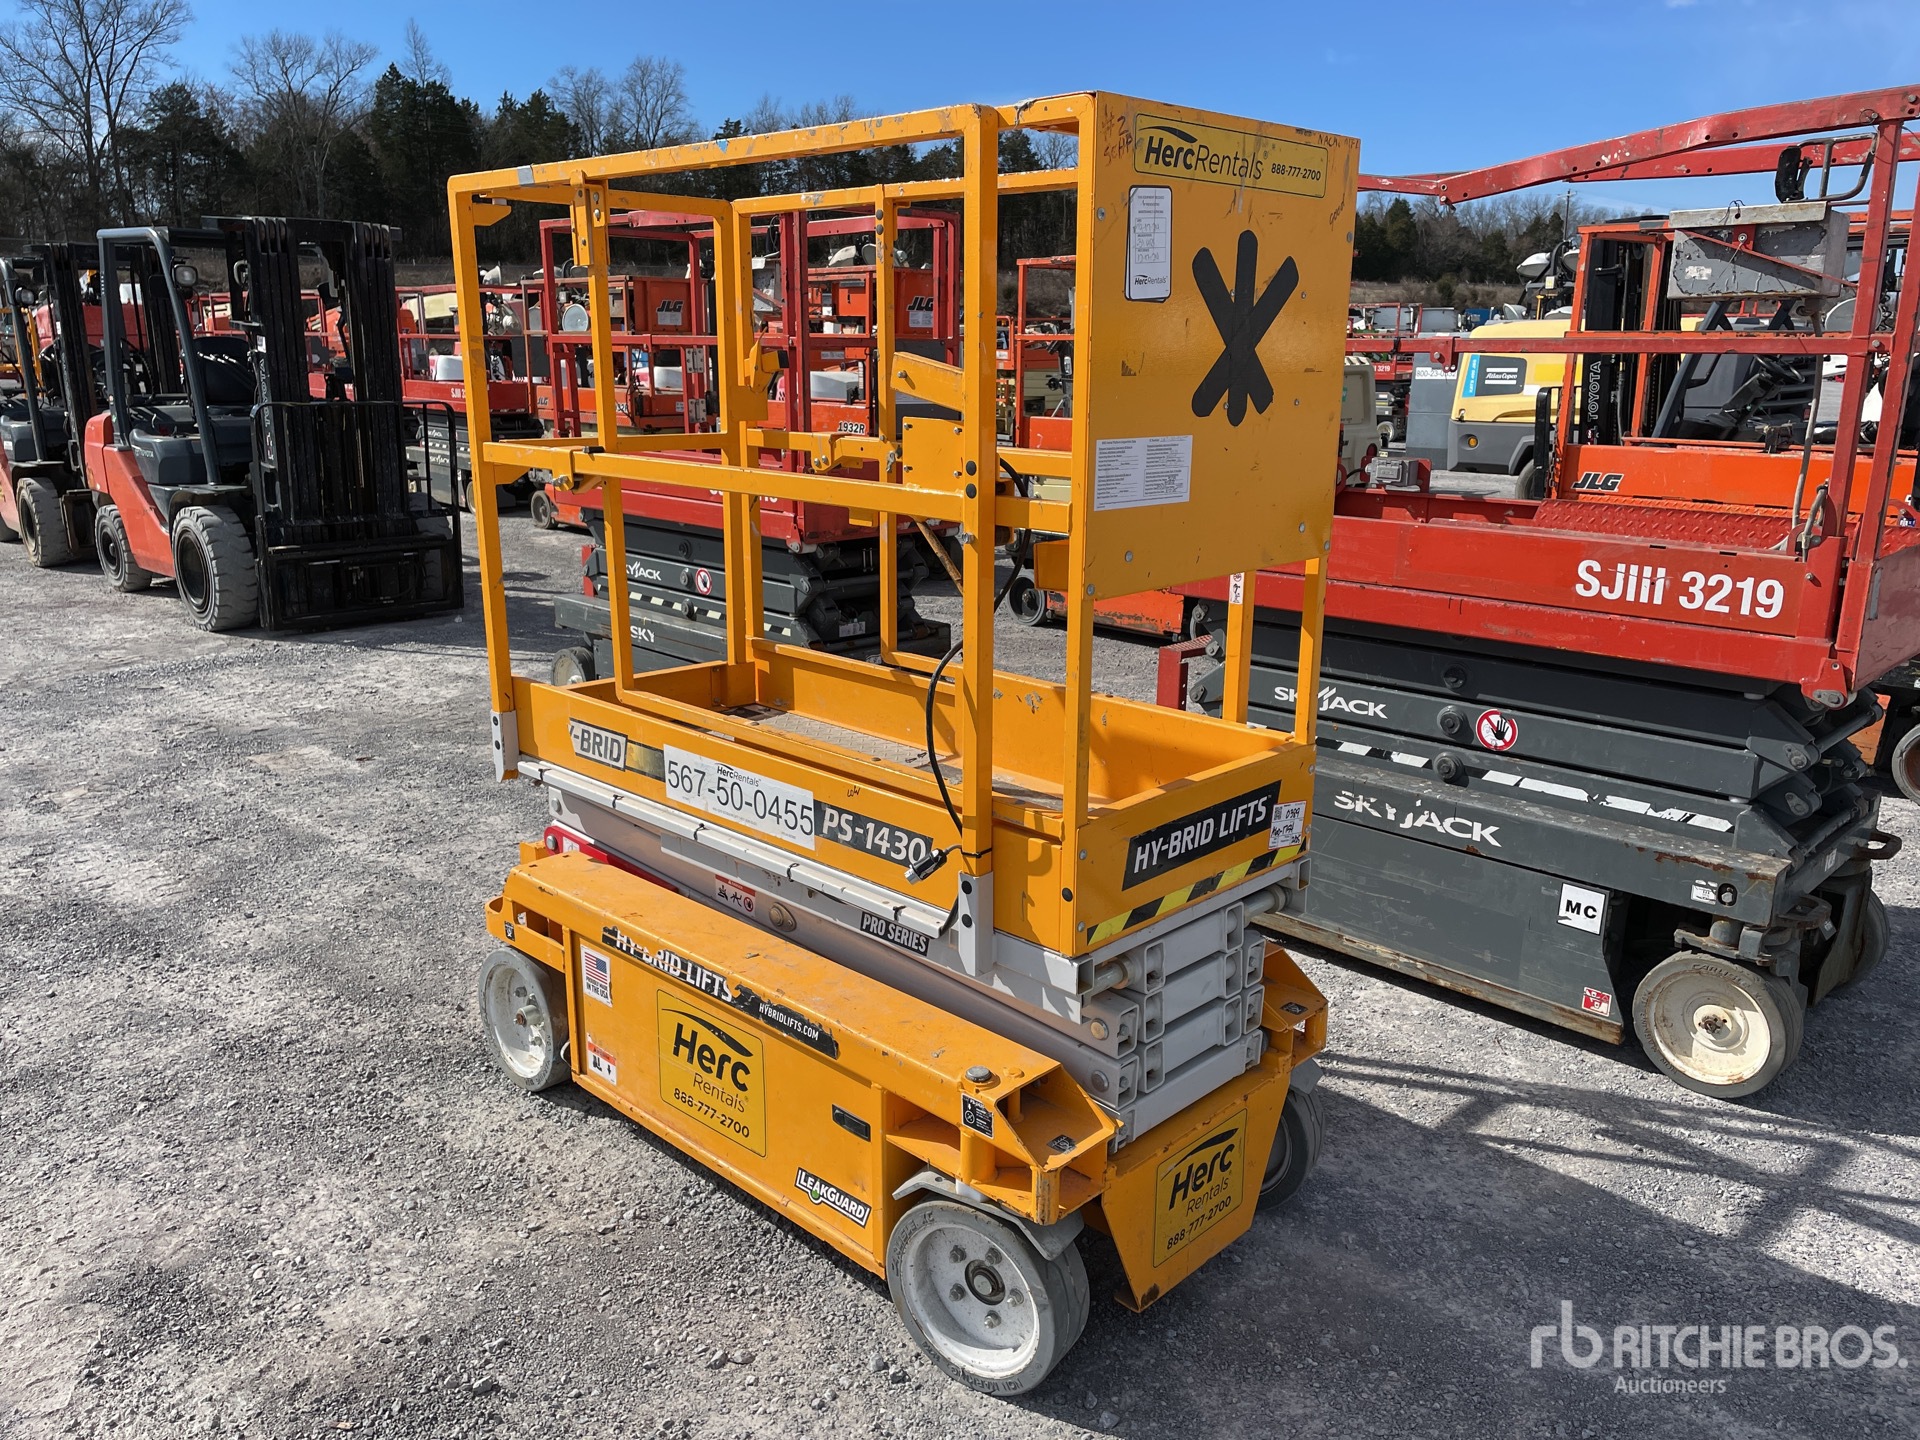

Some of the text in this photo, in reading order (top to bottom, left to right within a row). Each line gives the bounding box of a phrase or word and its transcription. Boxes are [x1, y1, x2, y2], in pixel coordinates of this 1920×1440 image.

[1271, 163, 1322, 181] 888-777-2700
[656, 300, 684, 313] JLG
[906, 297, 934, 312] JLG
[1588, 360, 1601, 422] TOYOTA
[837, 421, 866, 434] 1932R
[1571, 471, 1624, 492] JLG
[1678, 570, 1785, 619] 3219
[569, 725, 622, 764] -BRID
[668, 759, 814, 836] 567-50-0455
[822, 807, 927, 864] PS-1430
[1134, 795, 1268, 874] HY-BRID LIFTS
[1565, 899, 1598, 920] MC
[862, 913, 927, 953] PRO SERIES
[686, 960, 734, 1003] LIFTS
[758, 1002, 820, 1041] HYBRIDLIFTS.COM
[672, 1022, 751, 1092] Herc
[674, 1087, 751, 1139] 888-777-2700
[692, 1072, 746, 1113] Rentals
[1168, 1143, 1236, 1211] Herc
[1185, 1176, 1230, 1218] Rentals
[1166, 1195, 1233, 1251] 888-777-2700
